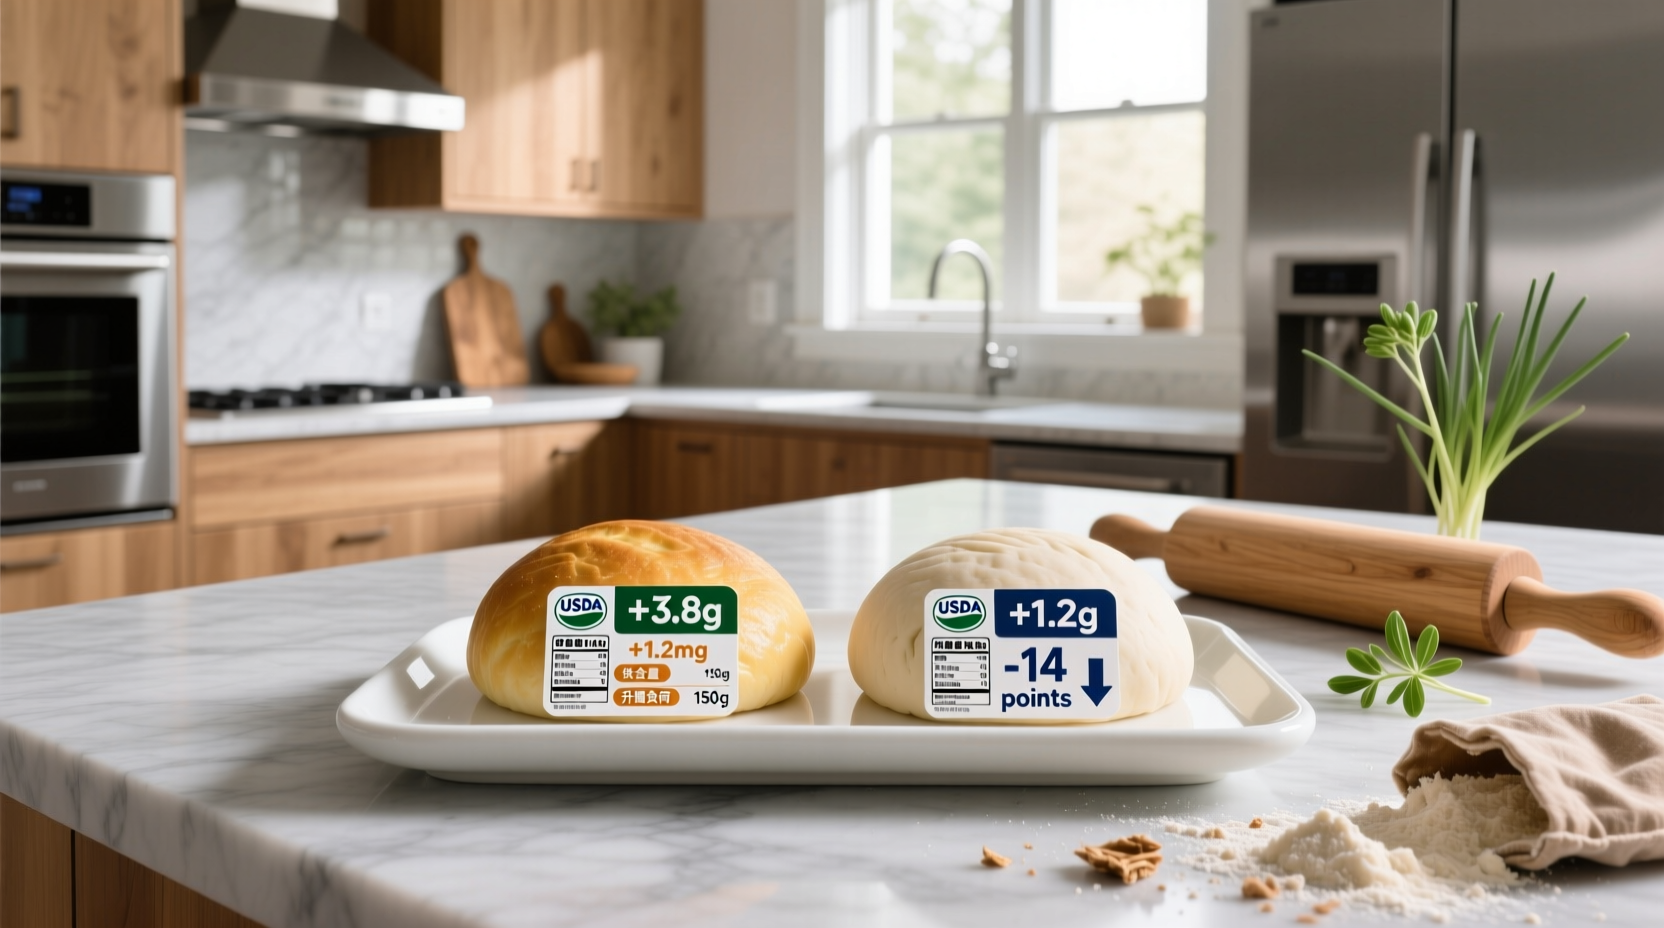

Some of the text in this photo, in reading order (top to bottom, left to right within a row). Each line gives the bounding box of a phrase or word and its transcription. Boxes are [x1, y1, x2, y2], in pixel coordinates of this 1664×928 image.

[561, 598, 603, 612] USDA
[628, 595, 722, 631] +3.8g
[937, 600, 982, 614] USDA
[1009, 598, 1098, 635] +1.2g
[629, 640, 708, 663] +1.2mg
[1004, 646, 1067, 682] -14
[694, 690, 729, 708] 150g
[1001, 688, 1072, 712] points
